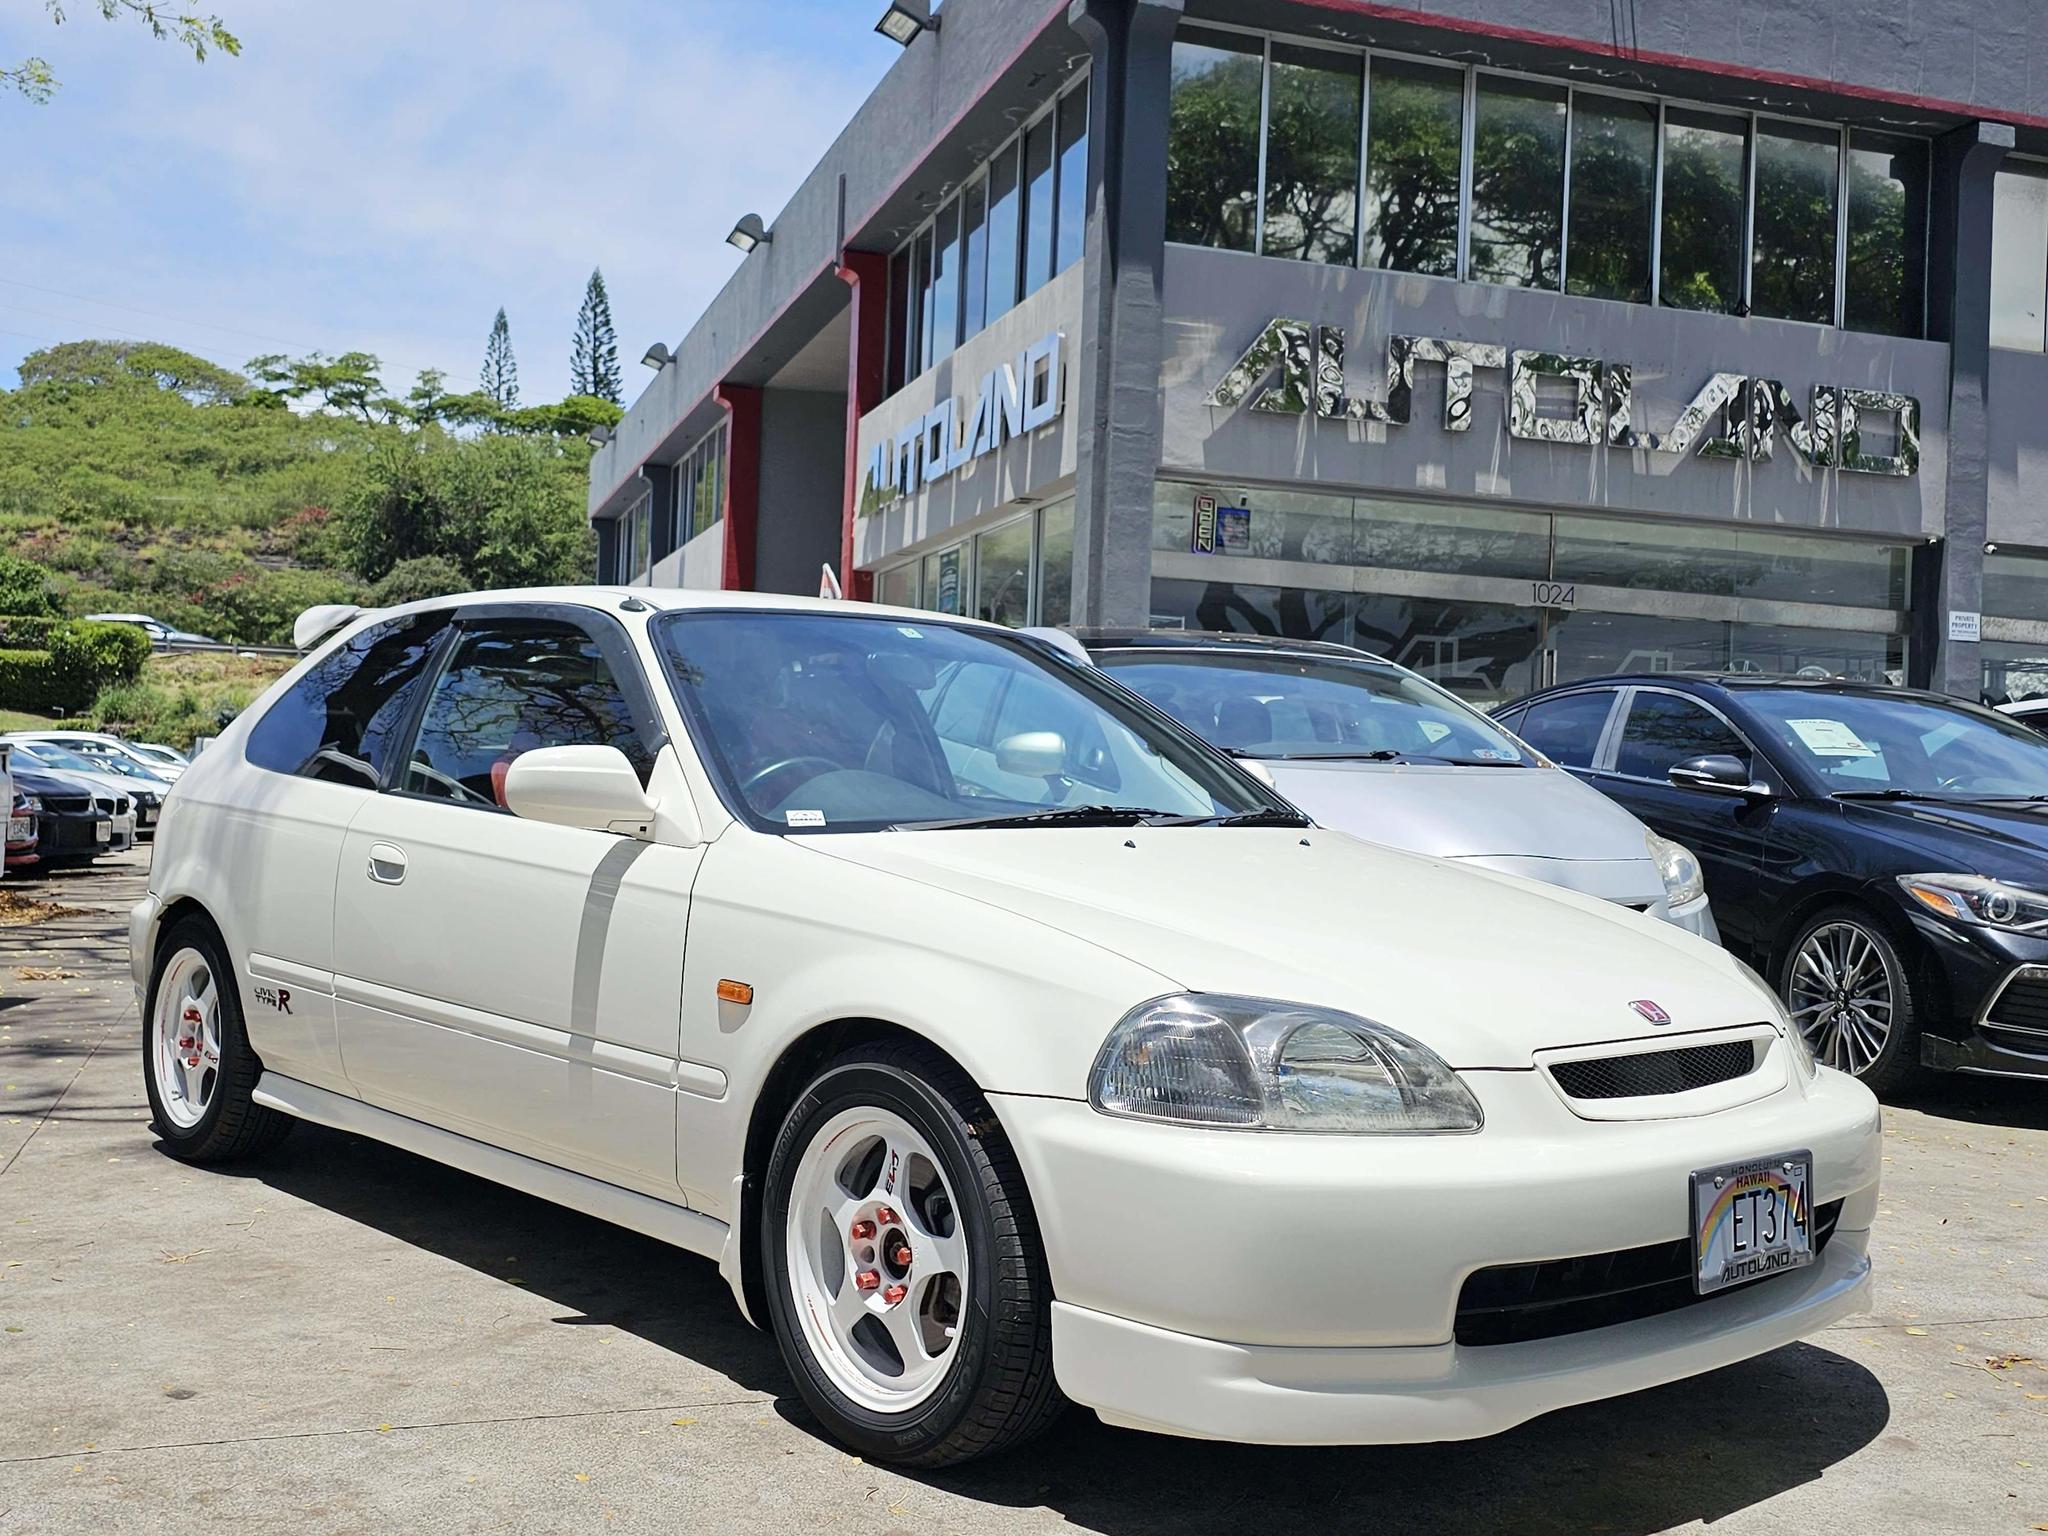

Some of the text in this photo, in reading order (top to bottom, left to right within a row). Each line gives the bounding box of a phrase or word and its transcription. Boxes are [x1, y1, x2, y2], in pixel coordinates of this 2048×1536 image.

[1204, 317, 1920, 477] AUTOLAND
[859, 331, 1062, 518] AUTOLAND
[1532, 582, 1575, 606] 1024
[1951, 622, 1978, 630] PROPERTY
[1955, 615, 1975, 623] PRIVATE
[255, 988, 293, 1015] TYPE R
[1736, 1171, 1770, 1189] HAWAII
[1732, 1180, 1807, 1253] ET374
[1721, 1251, 1790, 1284] AUTOLAND
